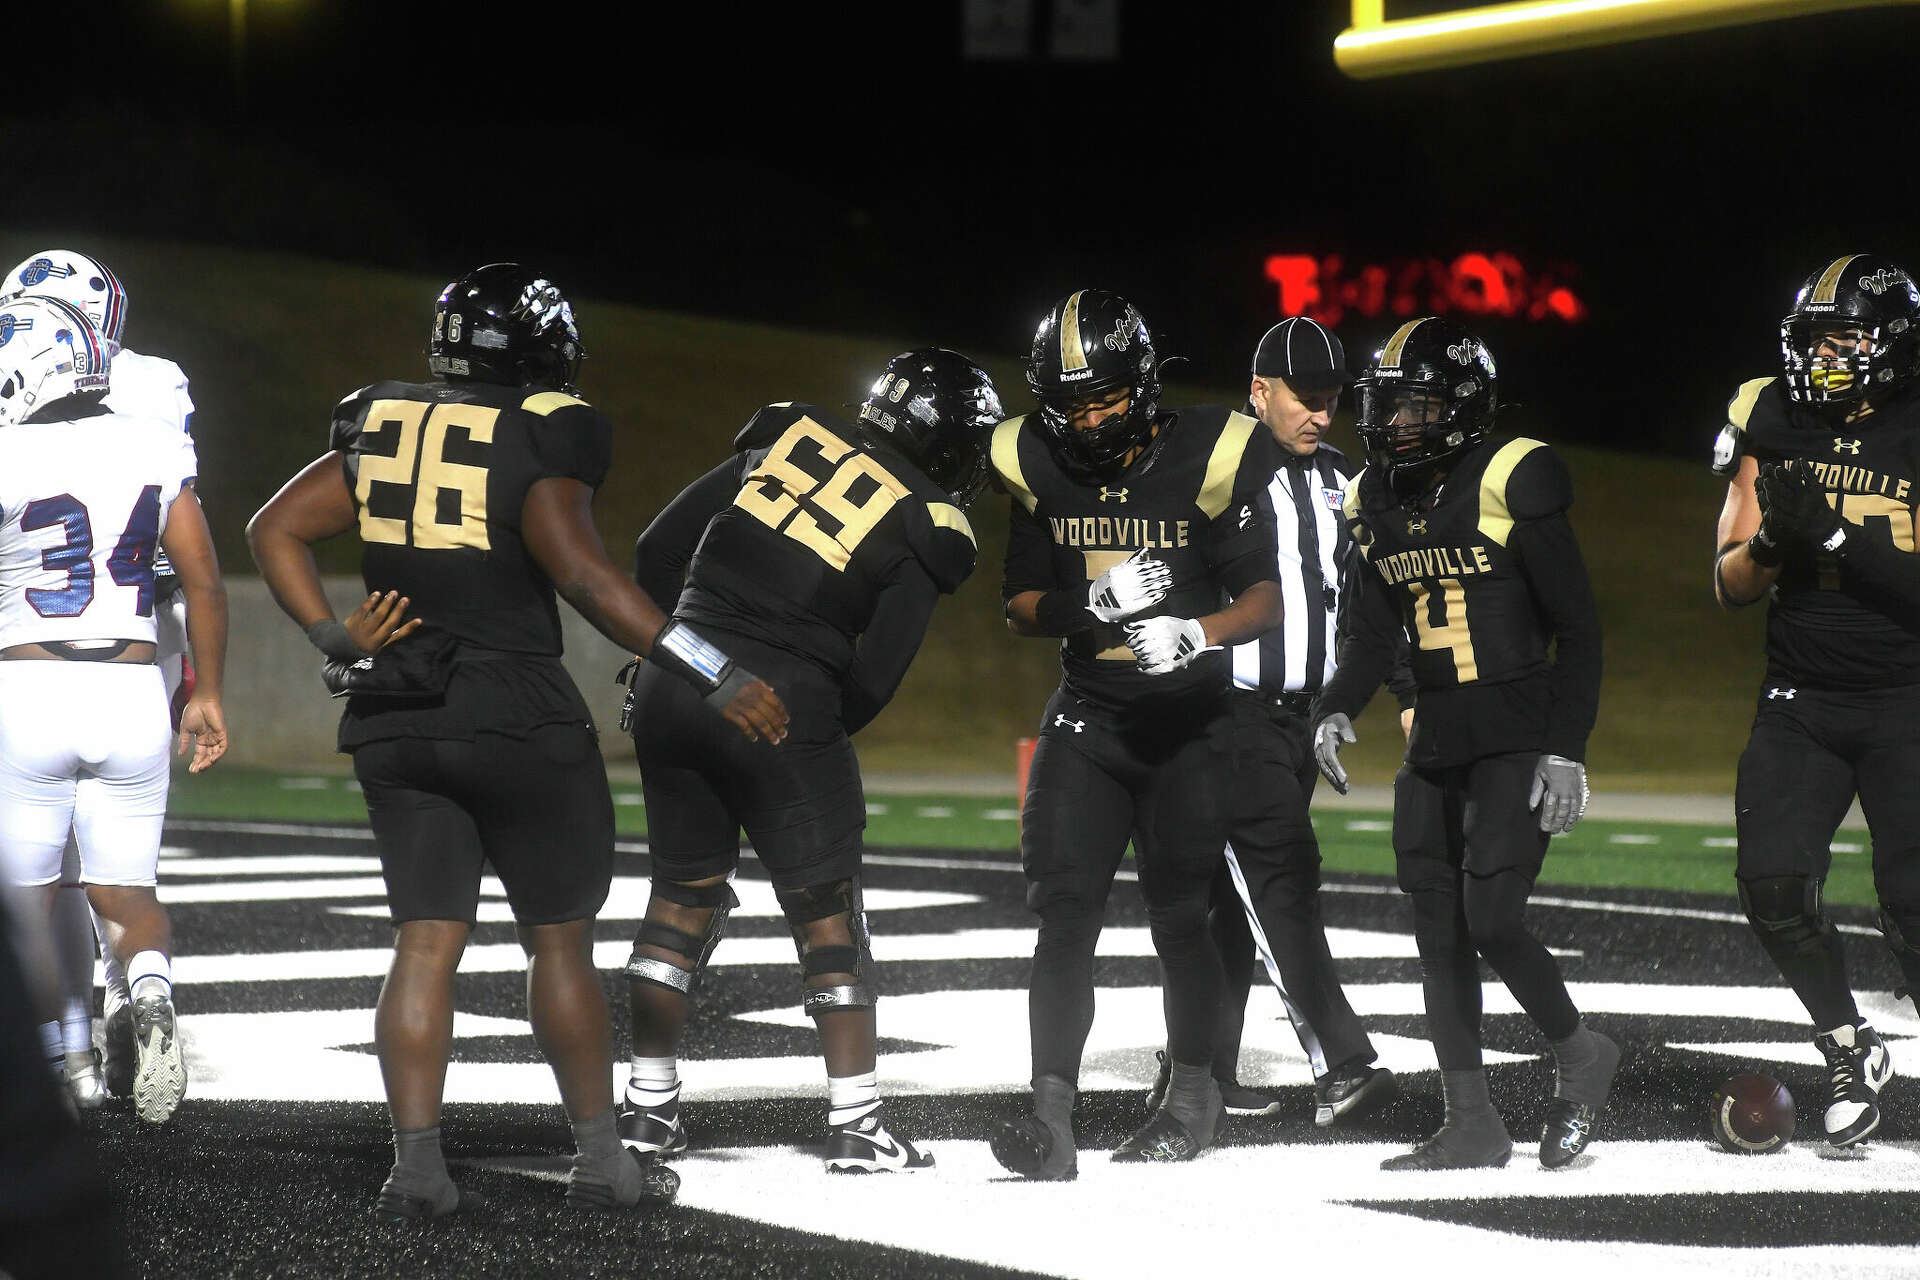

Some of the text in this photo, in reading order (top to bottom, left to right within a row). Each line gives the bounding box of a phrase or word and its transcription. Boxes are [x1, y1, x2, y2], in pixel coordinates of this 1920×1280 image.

[1059, 369, 1094, 383] Riddell
[355, 399, 501, 551] 26
[733, 414, 913, 573] 69
[20, 484, 162, 618] 34
[1049, 516, 1190, 549] WOODVILLE
[1374, 546, 1493, 585] WOODVILLE
[1407, 578, 1479, 684] 4
